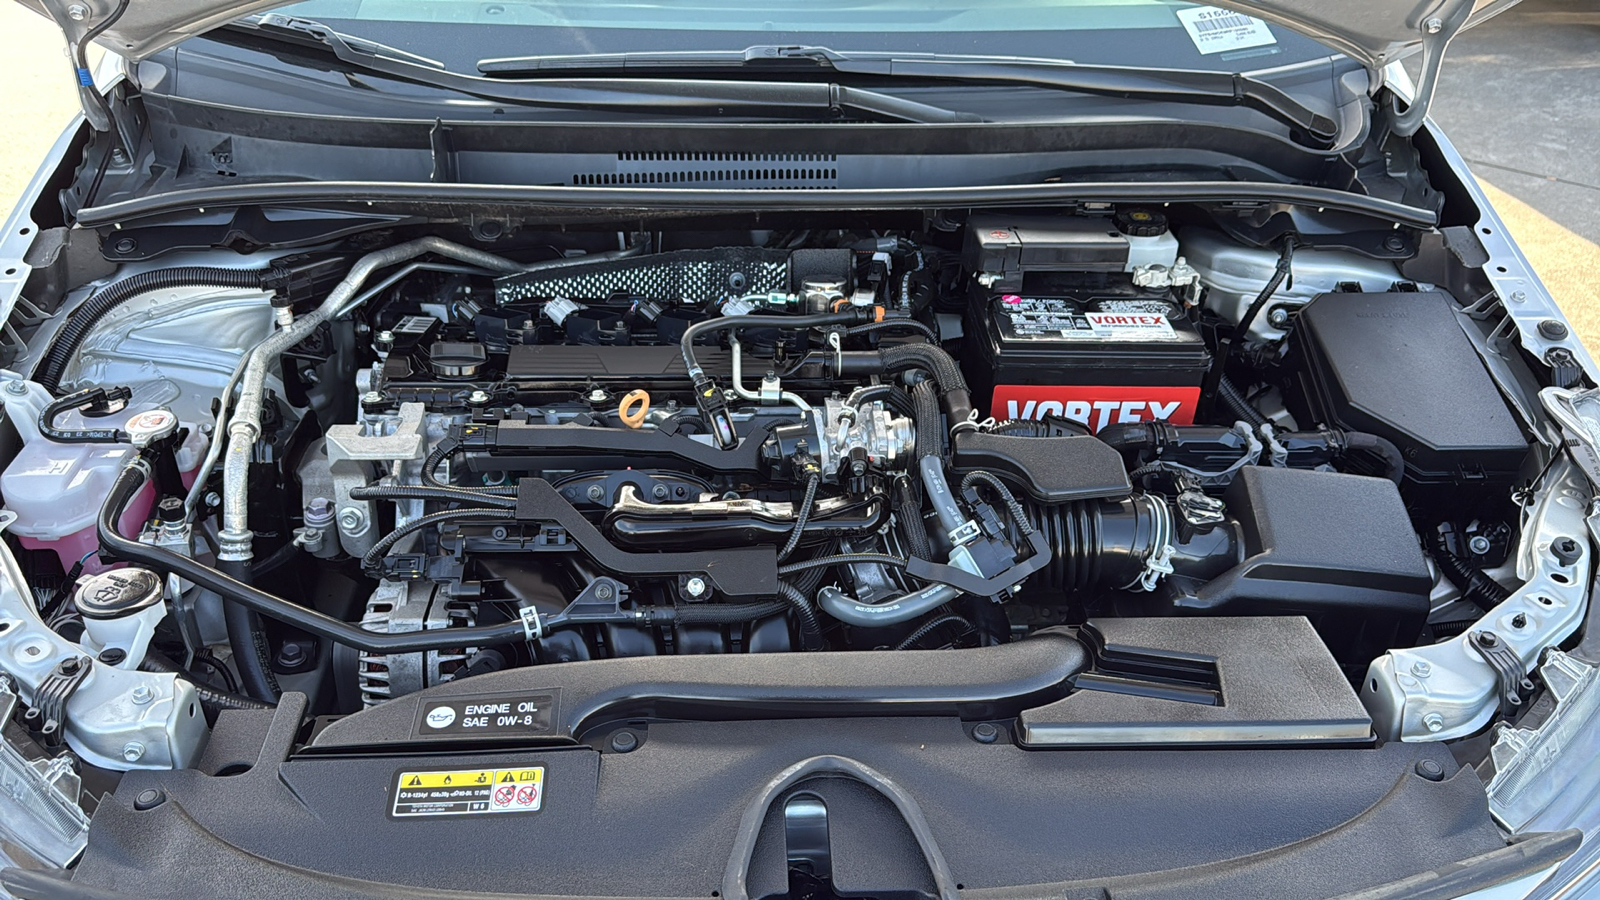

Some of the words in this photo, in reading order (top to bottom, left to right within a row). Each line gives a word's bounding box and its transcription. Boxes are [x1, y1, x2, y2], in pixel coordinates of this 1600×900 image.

[1090, 315, 1166, 325] VORTEX
[1404, 445, 1418, 458] K6
[49, 461, 68, 474] H
[464, 703, 511, 715] ENGINE
[517, 702, 538, 713] OIL
[462, 716, 489, 727] SAE
[497, 715, 533, 726] 0W-8
